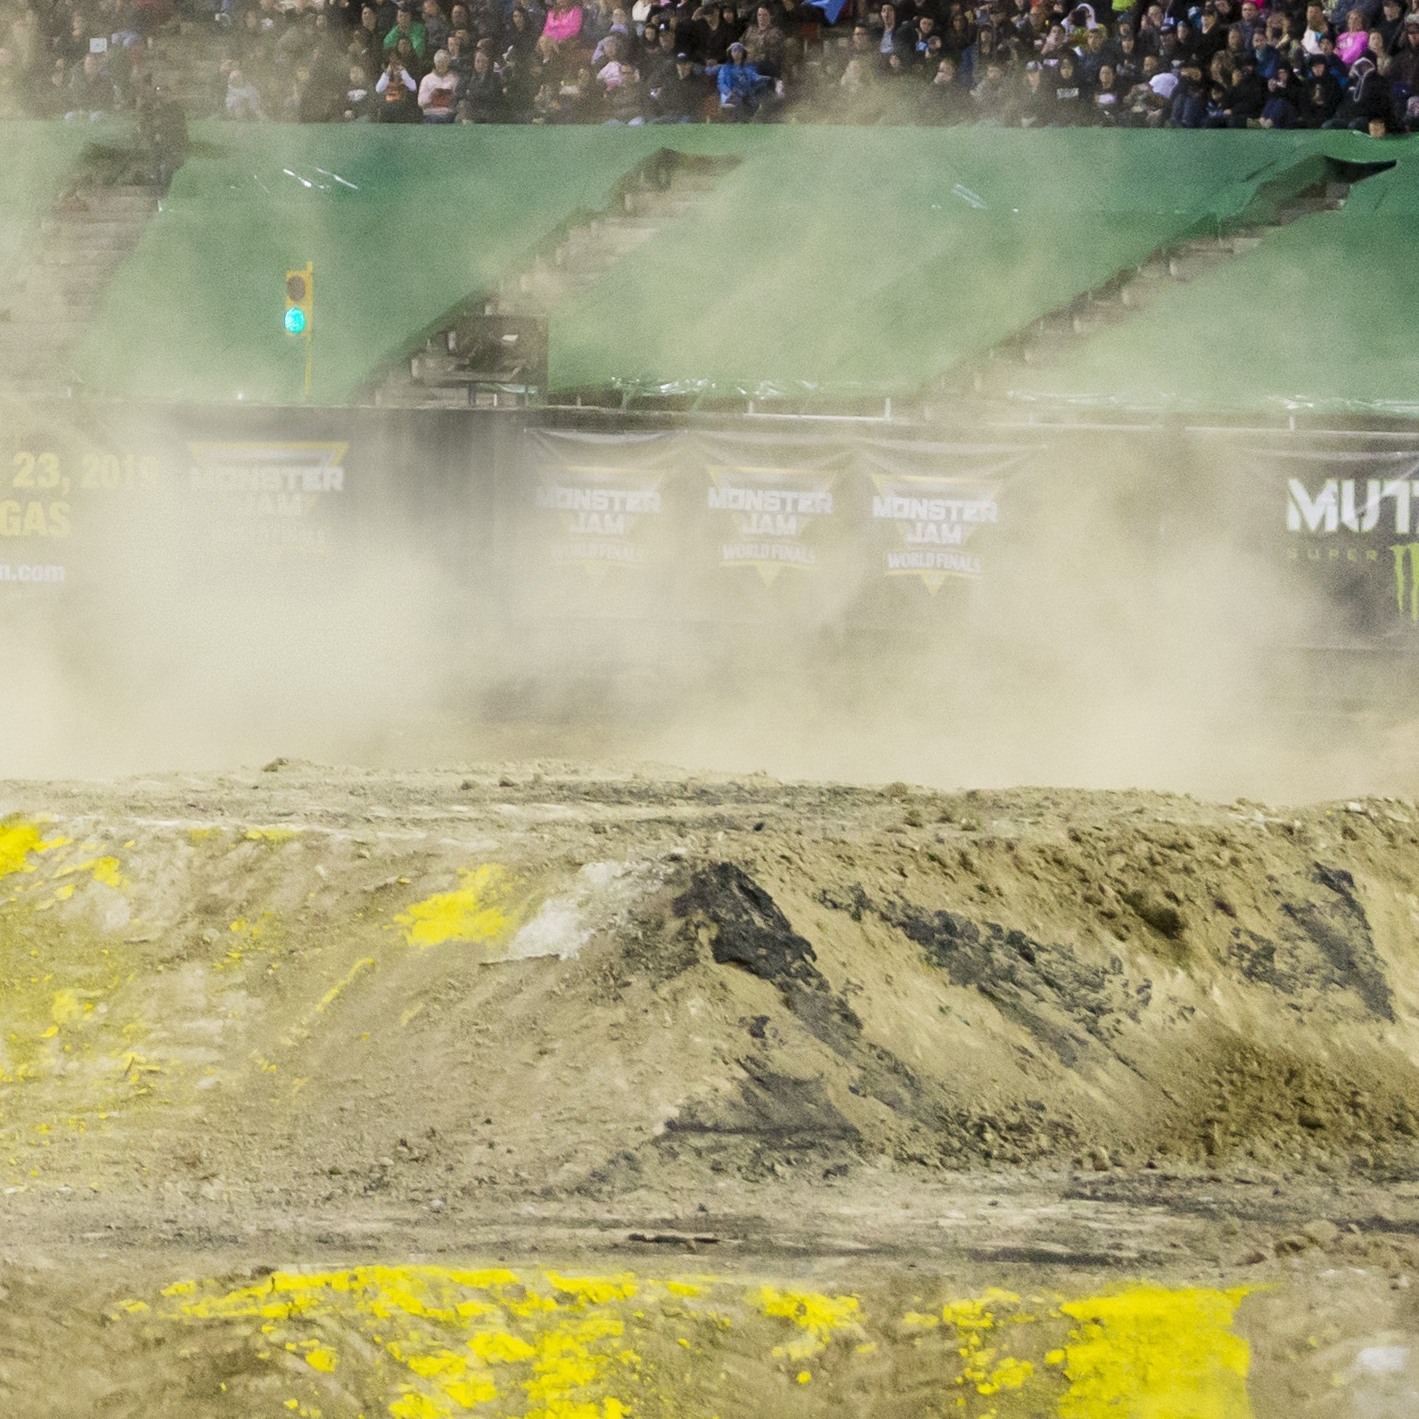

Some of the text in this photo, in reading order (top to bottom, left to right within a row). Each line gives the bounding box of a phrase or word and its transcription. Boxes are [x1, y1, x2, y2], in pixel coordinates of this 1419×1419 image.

[12, 451, 71, 495] 23,
[536, 485, 662, 513] MONSTER
[707, 486, 834, 515] MONSTER
[871, 495, 999, 524] MONSTER
[568, 512, 625, 535] JAM
[740, 512, 798, 536] JAM
[905, 521, 963, 545] JAM
